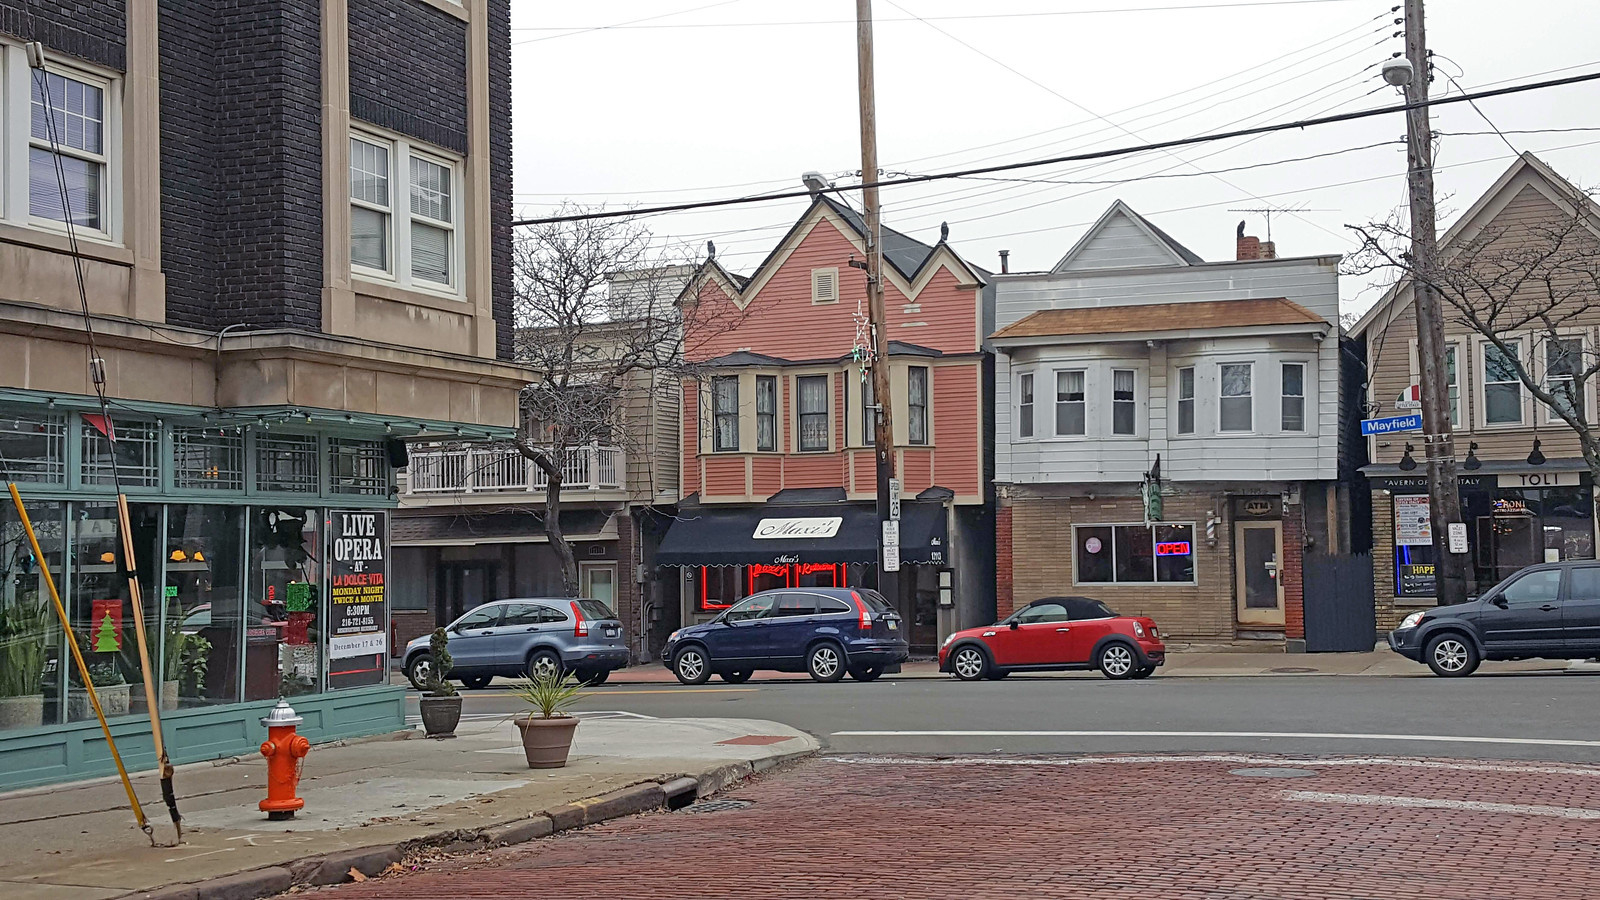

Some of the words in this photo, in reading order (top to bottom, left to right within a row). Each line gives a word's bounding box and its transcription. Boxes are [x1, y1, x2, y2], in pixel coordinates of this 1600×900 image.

[1367, 417, 1416, 431] Mayfield
[1519, 473, 1558, 486] TOLI
[891, 501, 899, 517] 25
[342, 514, 375, 536] LIVE
[759, 520, 835, 536] Maxi's
[334, 538, 383, 561] OPERA
[1157, 543, 1189, 554] OPEN
[774, 554, 800, 564] Maxi's
[354, 561, 364, 572] AT
[333, 574, 343, 586] LA
[344, 573, 367, 586] DOLCE
[369, 572, 384, 585] VITA
[332, 587, 361, 596] MONDAY
[363, 586, 384, 594] NIGHT
[333, 596, 354, 604] TWICE
[360, 595, 383, 603] MONTH
[346, 605, 370, 616] 6:30PM
[341, 616, 374, 627] 216-721-8155
[333, 643, 361, 651] December
